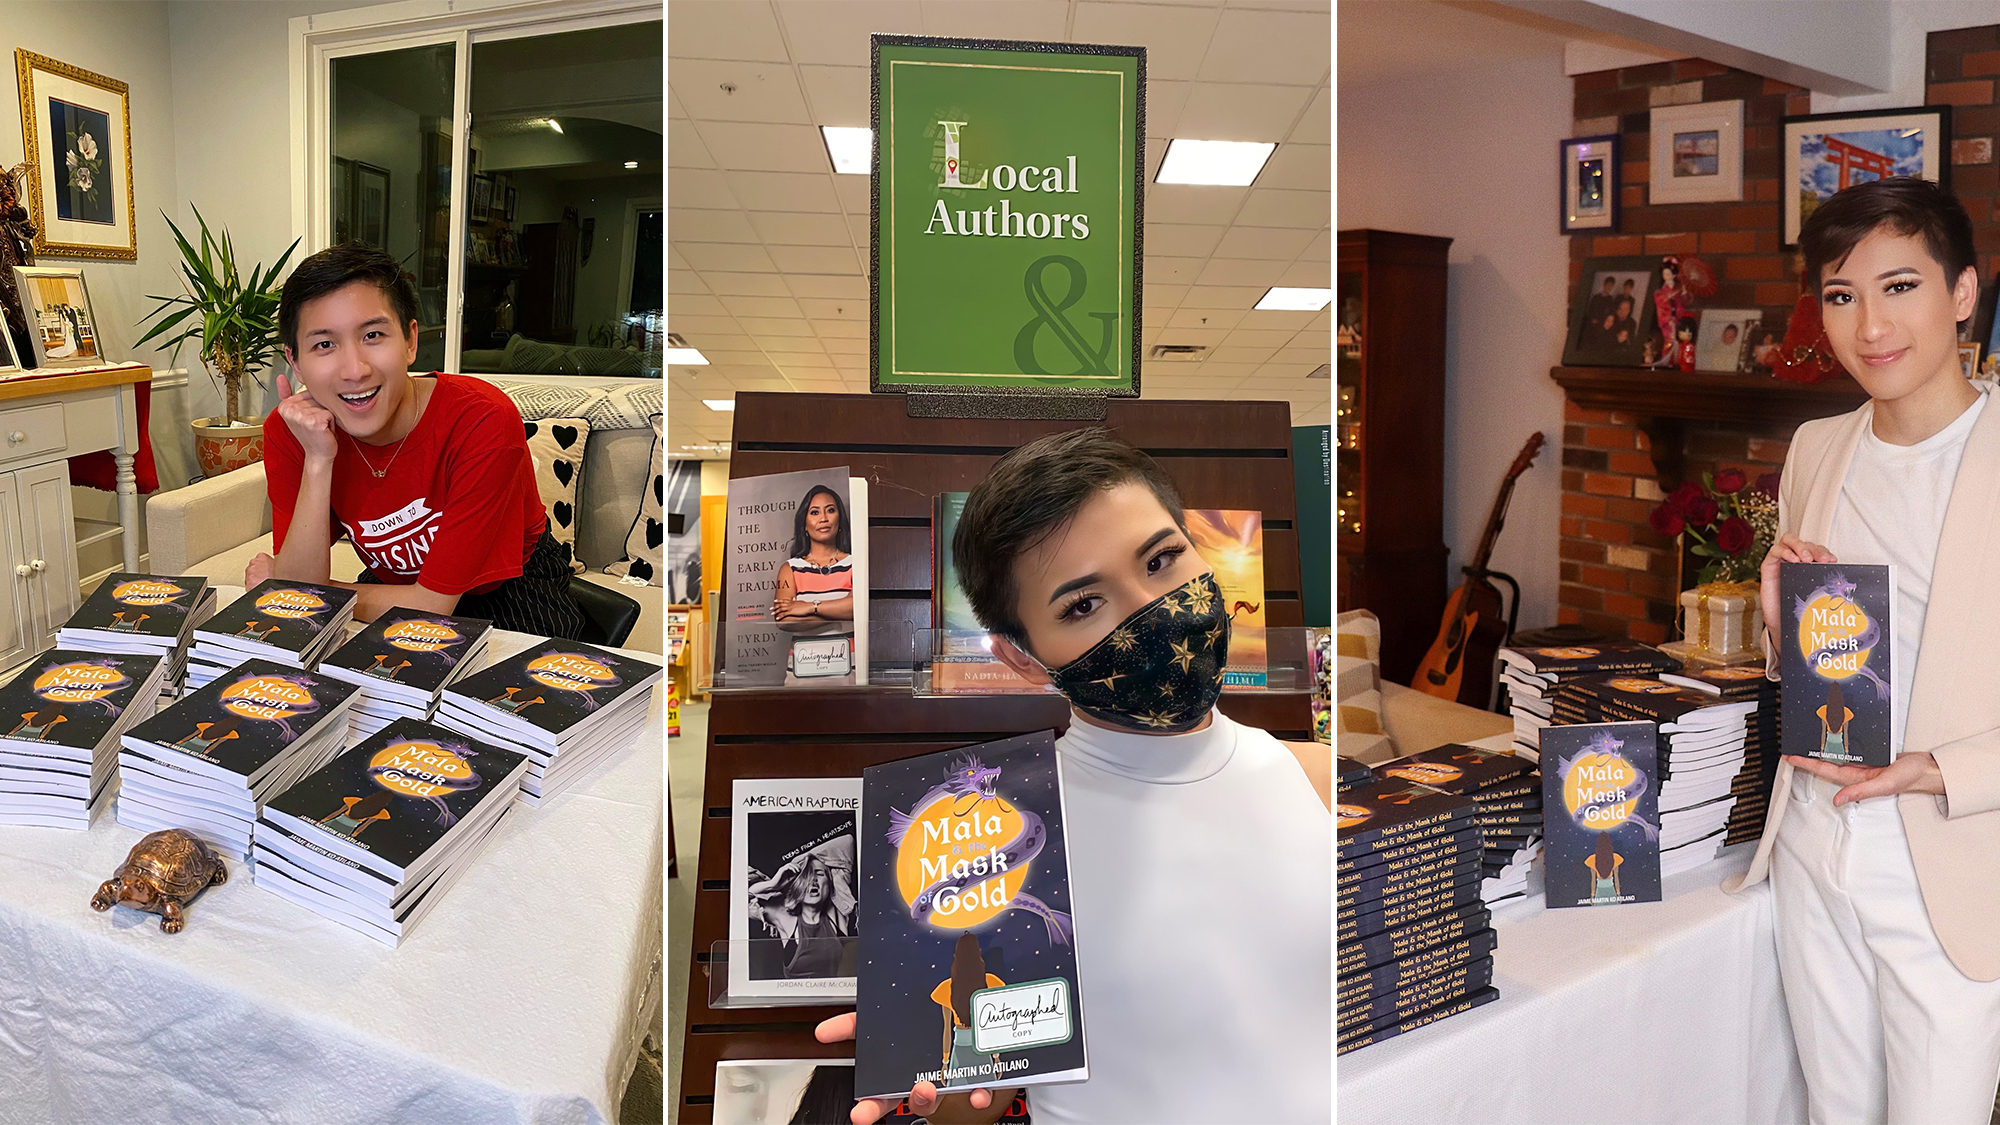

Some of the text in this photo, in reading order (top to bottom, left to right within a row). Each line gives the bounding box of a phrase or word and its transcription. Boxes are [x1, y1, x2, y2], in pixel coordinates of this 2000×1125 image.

[937, 120, 1079, 193] Local
[923, 199, 1090, 240] Authors
[737, 500, 796, 516] THROUGH
[371, 506, 417, 532] DOWN TO
[737, 524, 760, 535] THE
[737, 541, 777, 554] STORM
[737, 561, 776, 574] EARLY
[127, 583, 170, 592] Mala
[737, 580, 790, 593] TRAUMA
[126, 596, 165, 604] Gold
[272, 592, 315, 605] Mala
[266, 606, 304, 618] Gold
[1811, 608, 1856, 630] Mala
[393, 629, 441, 644] Mask
[401, 622, 447, 636] Mala
[395, 637, 435, 651] Gold
[737, 647, 770, 658] LYNN
[1810, 631, 1859, 654] Mask
[797, 643, 847, 666] Autographed
[1817, 652, 1858, 672] Gold
[57, 667, 111, 680] Mala
[538, 662, 592, 684] Mask
[552, 656, 603, 676] Mala
[45, 677, 104, 691] Mask
[247, 679, 300, 700] Mala
[538, 671, 582, 690] Gold
[48, 687, 98, 700] Gold
[232, 688, 289, 711] Mask
[232, 699, 280, 719] Gold
[398, 745, 459, 773] Mala
[382, 755, 446, 786] Mask
[1577, 764, 1624, 787] Mala
[382, 769, 436, 797] Gold
[742, 795, 860, 809] AMERICAN RAPTURE
[1576, 786, 1627, 808] Mask
[1584, 803, 1628, 822] Gold
[315, 821, 338, 835] MARTIN
[336, 832, 347, 840] KO
[345, 836, 371, 850] ATILANO
[921, 810, 1003, 855] Mala
[1381, 812, 1452, 838] Mala & the Mask of Gold
[306, 841, 328, 856] MARTIN
[326, 852, 337, 860] KO
[335, 856, 360, 869] ATILANO
[800, 839, 815, 852] FROM
[968, 841, 987, 852] the
[1382, 850, 1398, 861] Mala
[1399, 847, 1405, 856] &
[1414, 841, 1432, 854] Mask
[1433, 839, 1440, 847] of
[1440, 835, 1455, 845] Gold
[919, 845, 1008, 894] Mask
[919, 877, 1009, 916] of Gold
[1389, 930, 1404, 941] Mala
[1420, 919, 1438, 932] Mask
[1438, 916, 1444, 924] of
[1445, 911, 1459, 922] Gold
[1399, 959, 1414, 970] Mala
[1422, 953, 1431, 961] the
[1430, 947, 1448, 961] Mask
[1448, 944, 1455, 953] of
[1456, 940, 1470, 950] Gold
[978, 987, 1064, 1031] Autographed
[1400, 1022, 1416, 1034] Mala
[1432, 1010, 1450, 1023] Mask
[1450, 1006, 1457, 1015] of
[1457, 1001, 1472, 1012] Gold
[1012, 1029, 1033, 1039] COPY
[914, 1058, 1029, 1084] JAIME MARTIN KO ATILANO
